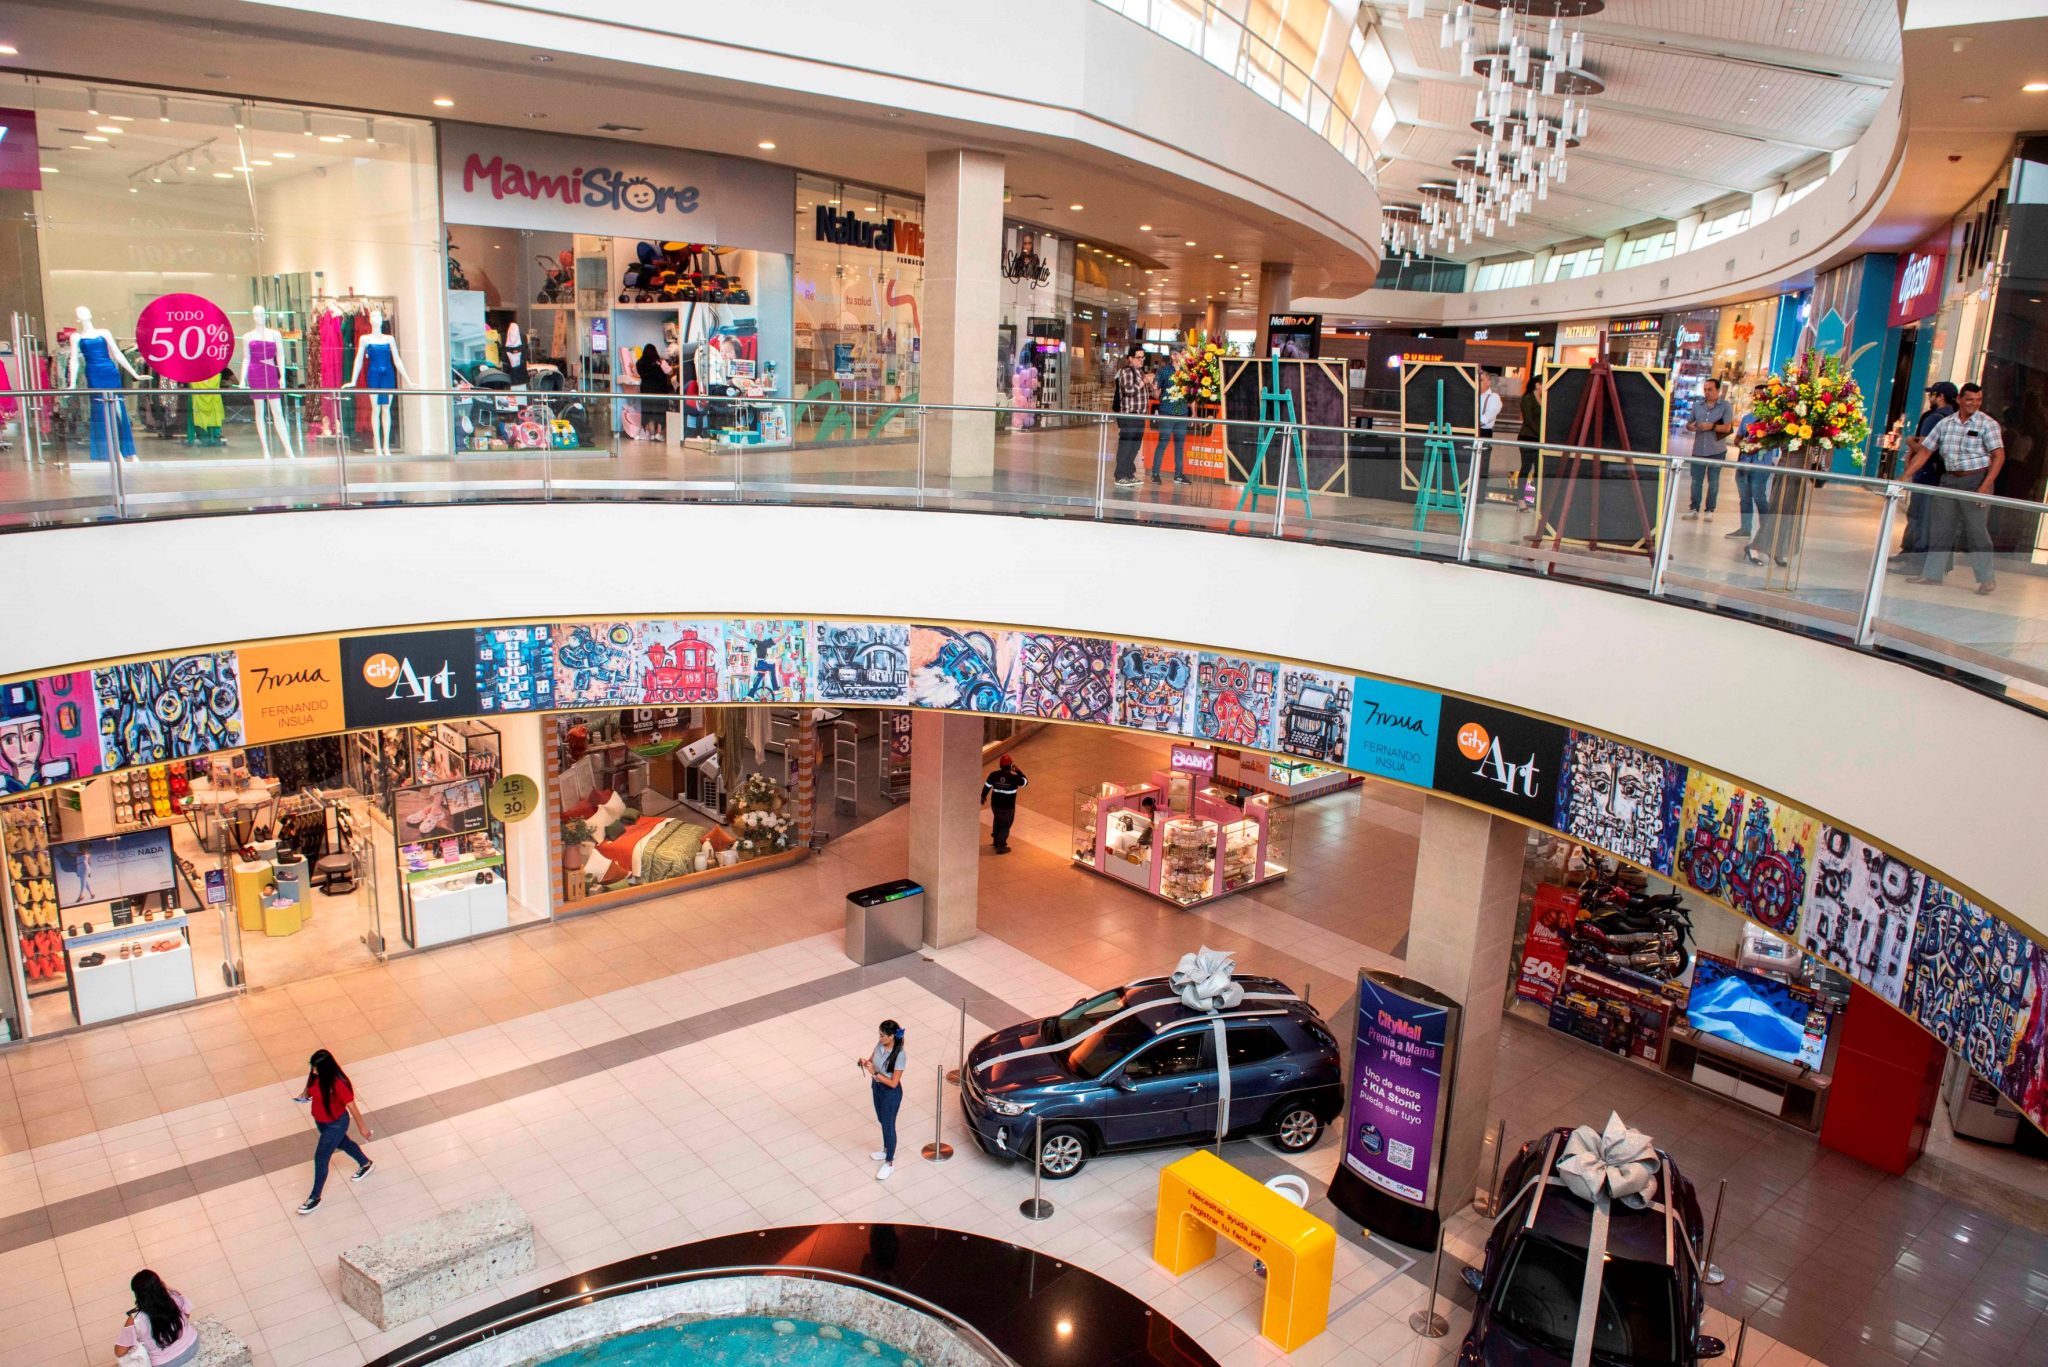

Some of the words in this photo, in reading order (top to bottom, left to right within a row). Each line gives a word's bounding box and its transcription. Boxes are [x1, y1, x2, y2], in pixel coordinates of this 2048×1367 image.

[463, 153, 700, 214] MamiStore
[166, 310, 204, 322] TODO
[148, 324, 229, 362] 50%
[1565, 325, 1596, 339] PATPRIMO
[206, 343, 230, 361] Off
[1403, 352, 1444, 362] DUNKIN'
[366, 659, 398, 679] City
[385, 657, 457, 704] Art
[261, 699, 329, 718] FERNANDO
[278, 715, 315, 729] INSUA
[892, 714, 910, 733] 18
[442, 730, 456, 746] KIDS
[1459, 729, 1488, 754] City
[1363, 740, 1421, 763] FERNANDO
[1375, 756, 1407, 773] INSUA
[1472, 735, 1540, 798] Art
[503, 780, 520, 794] 15
[503, 801, 522, 815] 30
[97, 852, 127, 863] COMO
[138, 846, 163, 856] NADA
[1523, 957, 1561, 979] 50%
[1377, 1009, 1422, 1041] CityMall
[1368, 1026, 1396, 1048] Premia
[1397, 1041, 1403, 1051] a
[1405, 1041, 1436, 1059] Mamá
[1382, 1049, 1388, 1060] y
[1390, 1050, 1412, 1067] Papá
[1365, 1065, 1381, 1082] Uno
[1382, 1078, 1393, 1089] de
[1395, 1085, 1421, 1100] estos
[1362, 1077, 1368, 1088] 2
[1369, 1081, 1385, 1098] KIA
[1388, 1092, 1421, 1112] Stonic
[1360, 1090, 1384, 1109] puede
[1385, 1105, 1400, 1117] ser
[1401, 1111, 1422, 1125] tuyo
[1190, 1204, 1218, 1226] registrar
[1221, 1224, 1230, 1233] tu
[1232, 1230, 1261, 1253] factura?
[1227, 1215, 1248, 1232] ayuda
[1250, 1230, 1267, 1244] para
